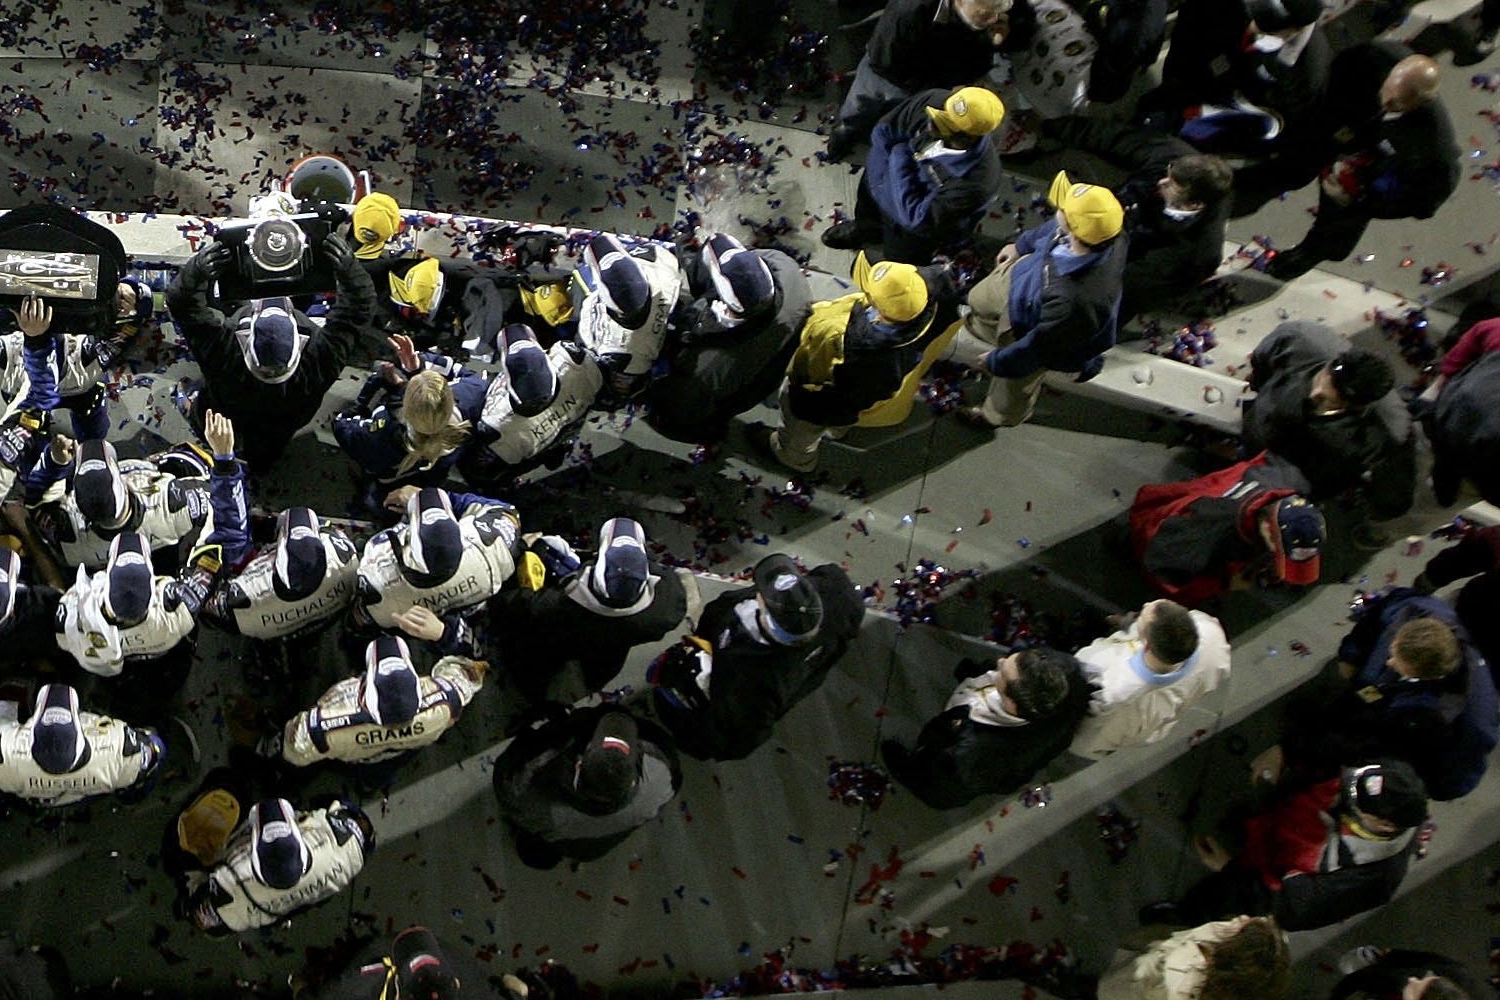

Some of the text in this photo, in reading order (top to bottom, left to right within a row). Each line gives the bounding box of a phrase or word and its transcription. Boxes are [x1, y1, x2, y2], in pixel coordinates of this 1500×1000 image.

[529, 393, 577, 438] KERLIN
[261, 581, 346, 628] PUCHALSKI
[412, 575, 479, 609] KNAUER
[356, 722, 425, 746] GRAMS
